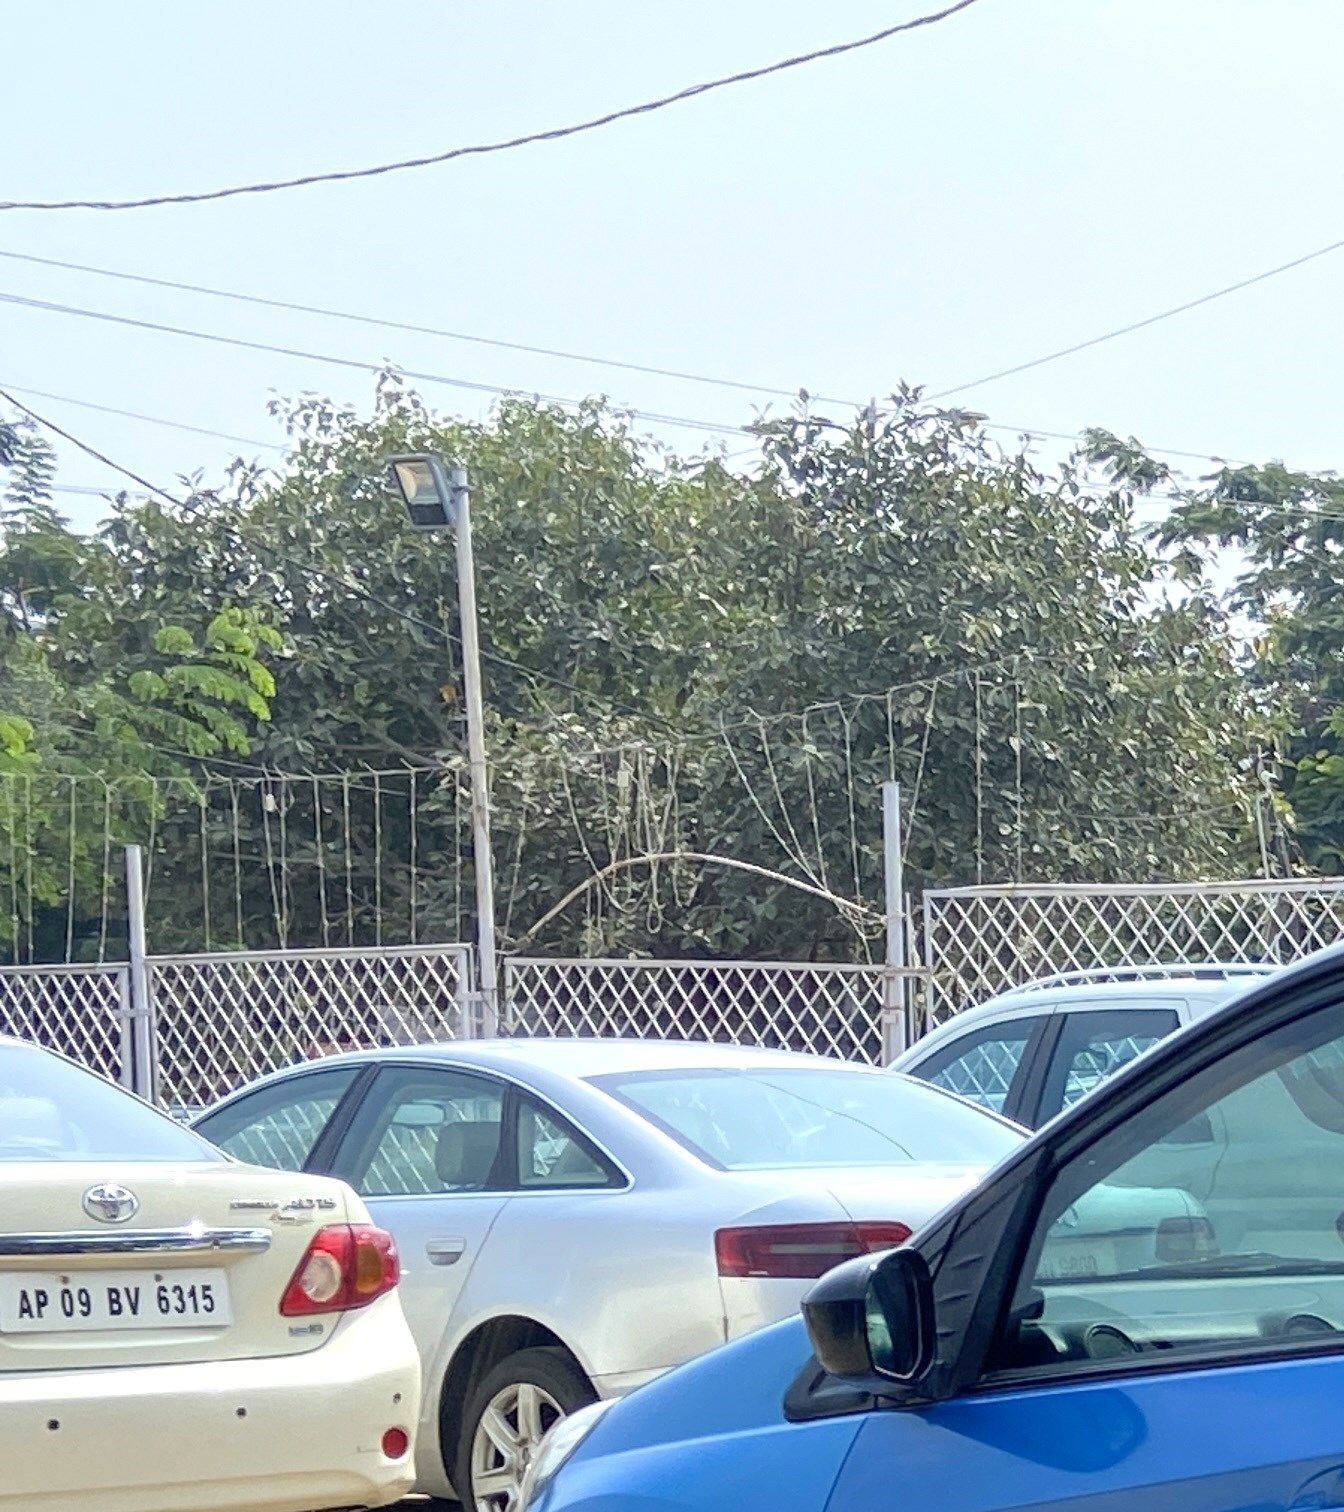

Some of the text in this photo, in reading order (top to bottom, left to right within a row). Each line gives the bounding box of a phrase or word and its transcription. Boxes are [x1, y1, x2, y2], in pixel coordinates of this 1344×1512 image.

[19, 1285, 215, 1318] AP 09 BV 6315
